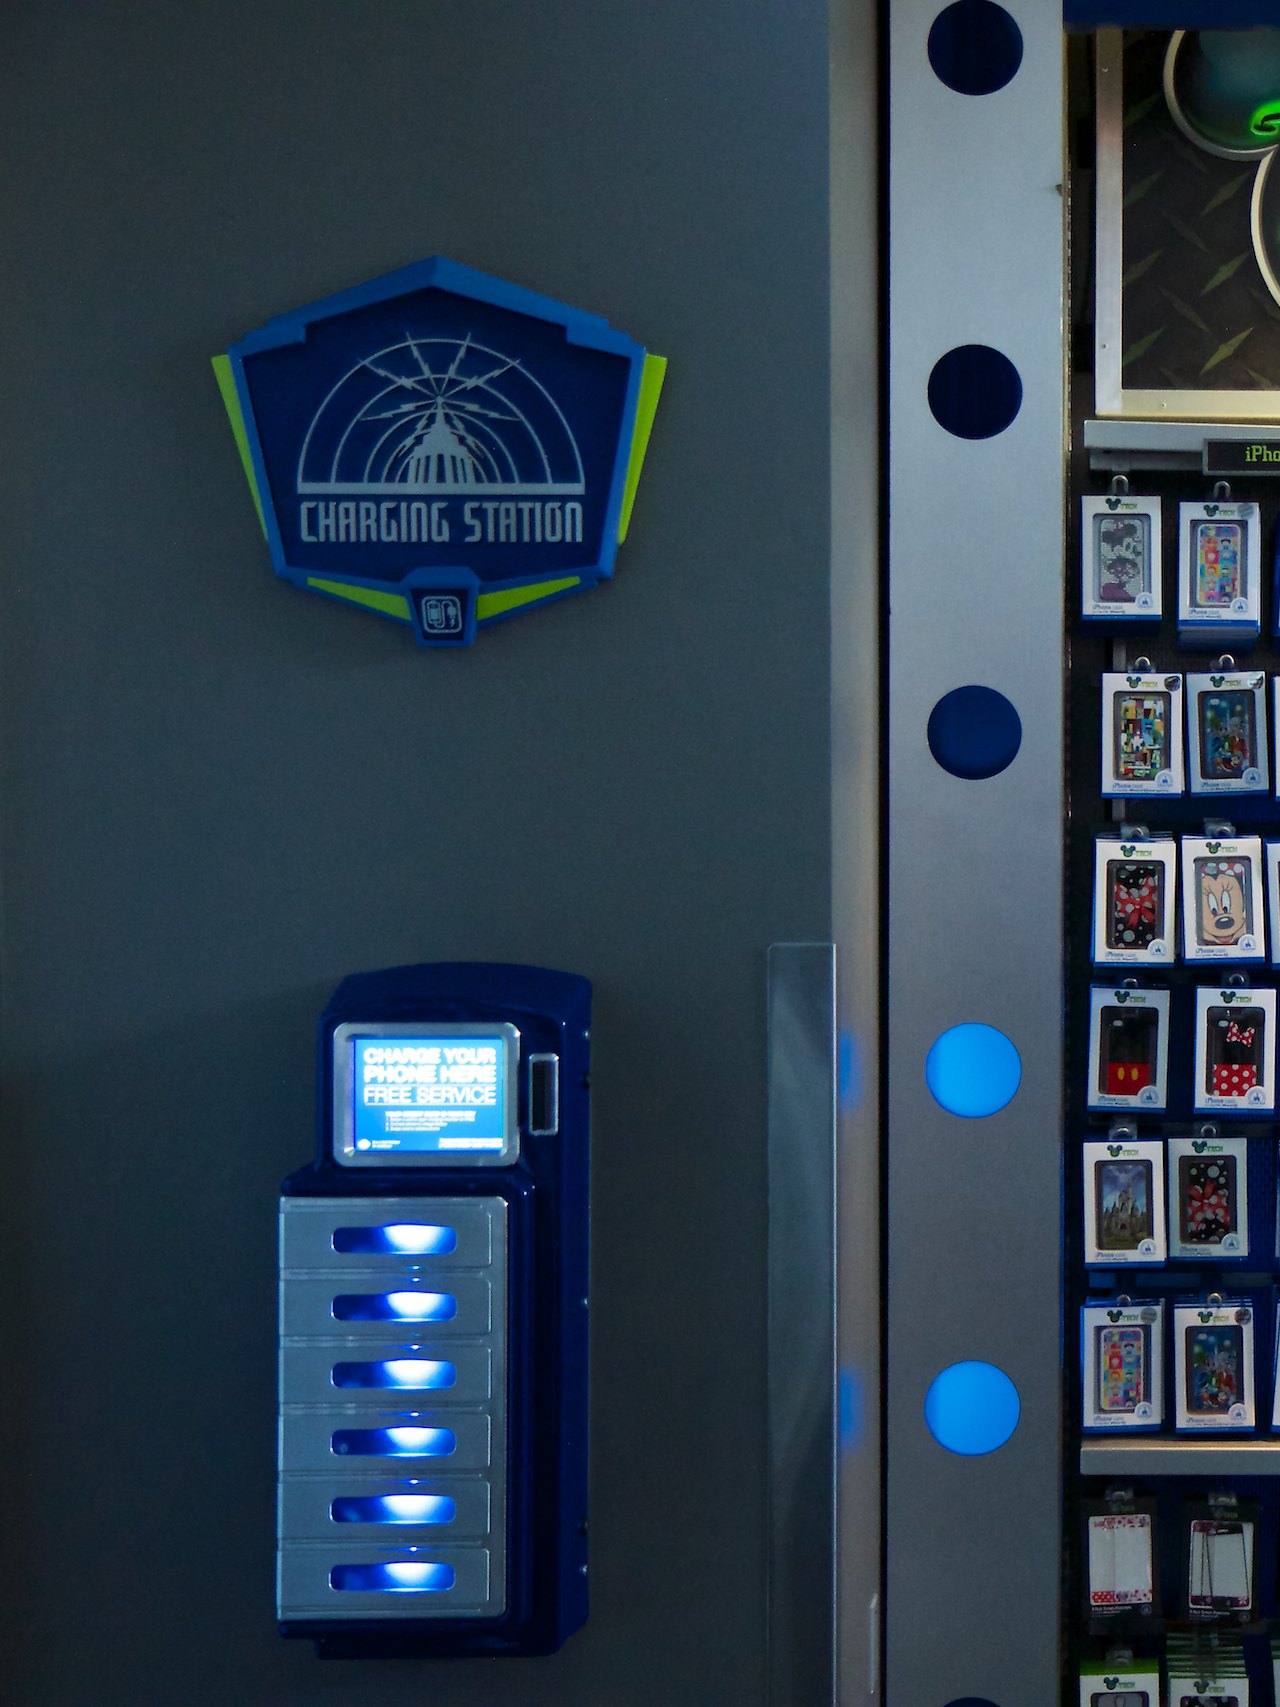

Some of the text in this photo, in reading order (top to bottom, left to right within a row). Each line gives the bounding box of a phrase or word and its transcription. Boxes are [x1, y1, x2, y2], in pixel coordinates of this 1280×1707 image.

[300, 502, 583, 542] CHARGING STATION
[363, 1047, 497, 1064] CHARGE YOUR
[363, 1065, 497, 1083] PHONE HERE
[363, 1086, 497, 1103] FREE SERVICE
